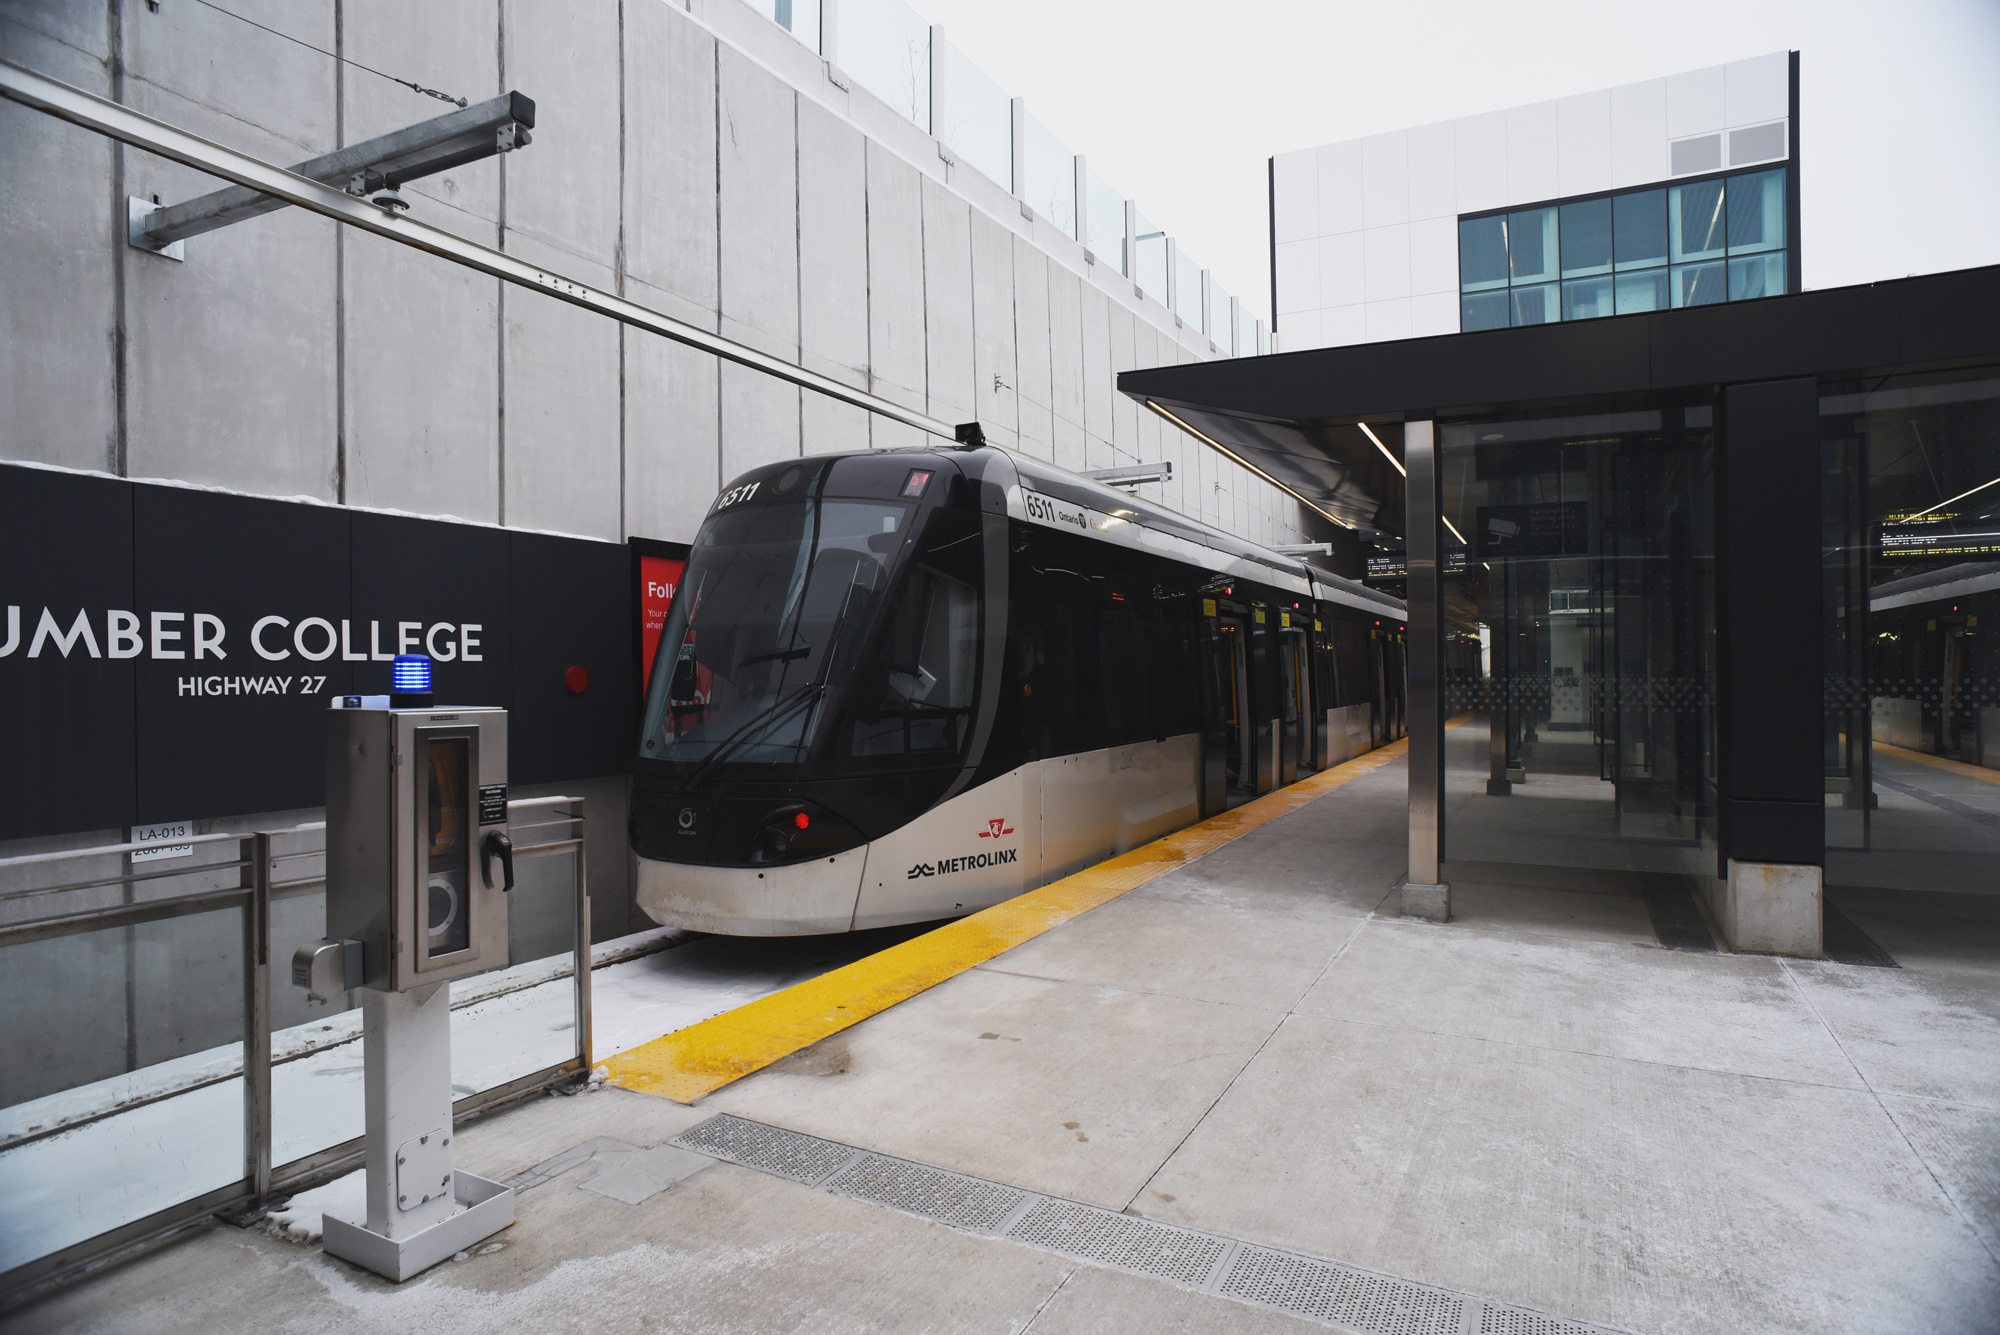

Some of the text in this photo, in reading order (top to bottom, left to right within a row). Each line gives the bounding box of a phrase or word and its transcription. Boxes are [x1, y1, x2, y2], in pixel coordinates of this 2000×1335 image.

[718, 482, 761, 510] 6511
[1027, 494, 1080, 525] 6511 Ontario
[648, 581, 676, 599] Foll
[648, 608, 662, 617] Your
[646, 621, 663, 629] when
[250, 615, 483, 662] COLLEGE
[178, 675, 327, 696] HIGHWAY 27
[139, 825, 186, 841] LA-013
[937, 848, 1018, 876] METROLINX
